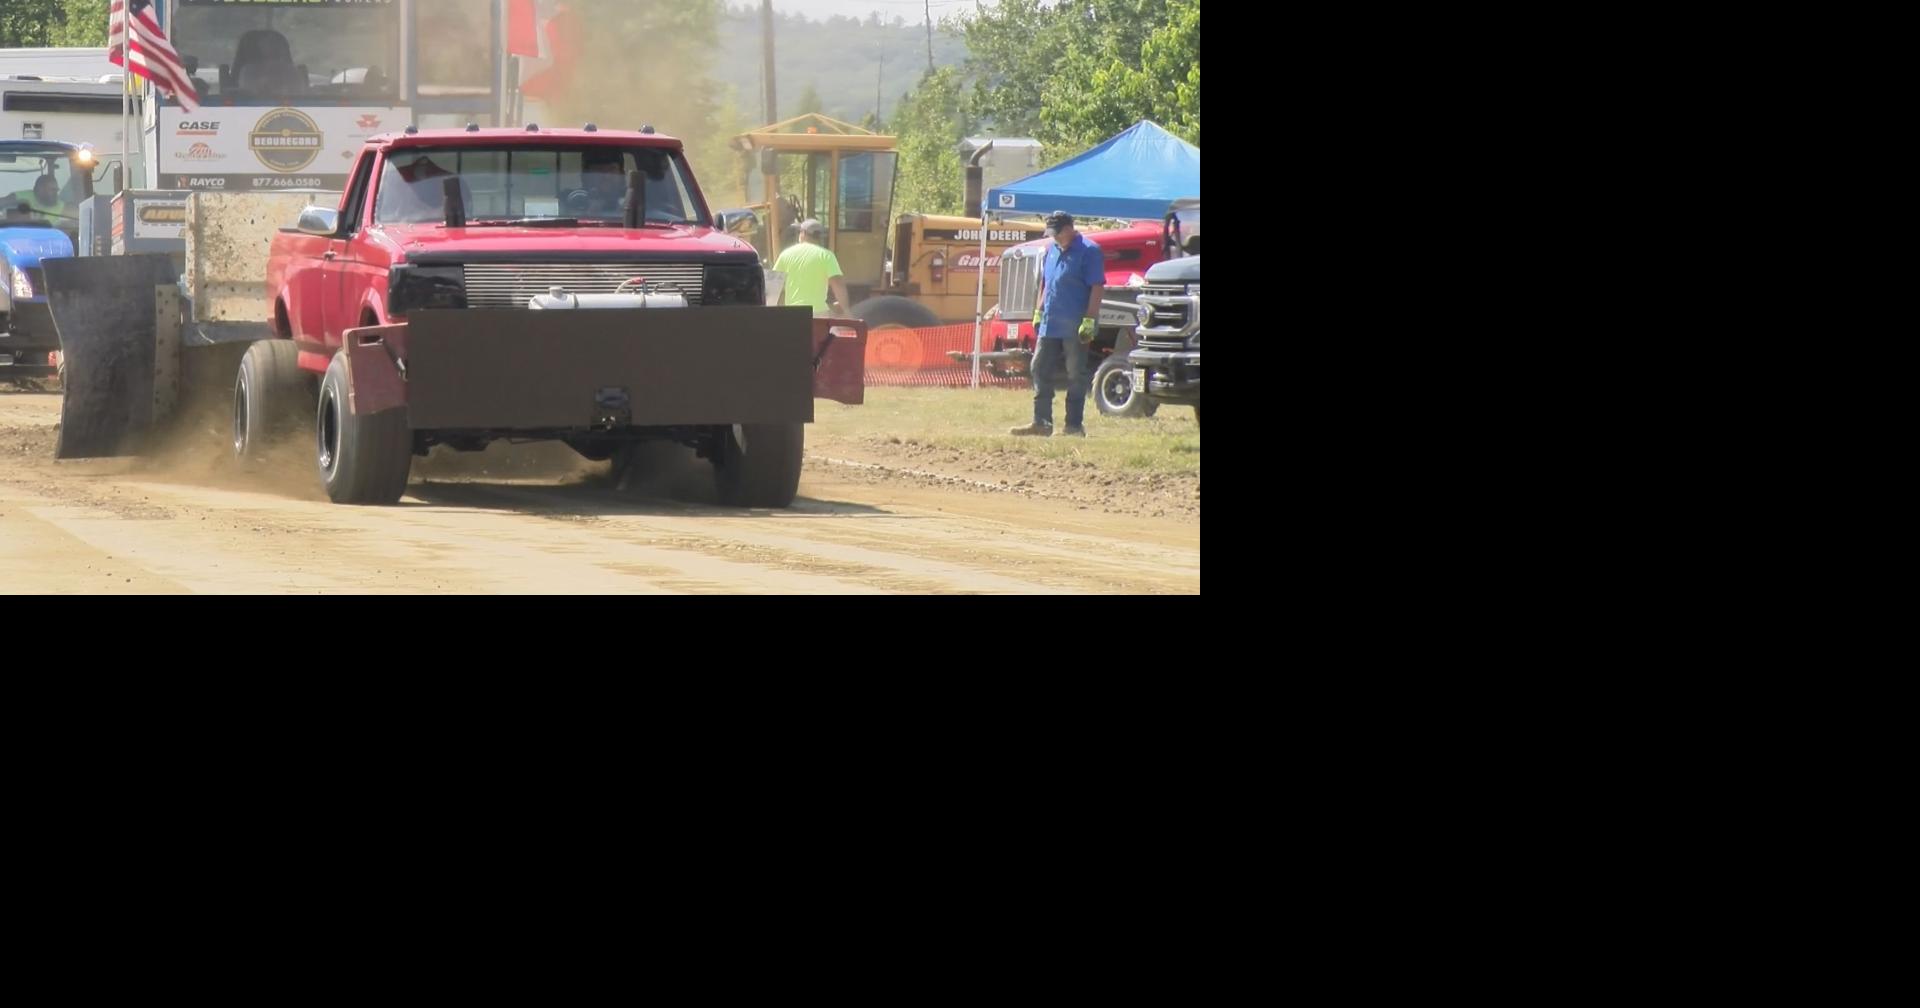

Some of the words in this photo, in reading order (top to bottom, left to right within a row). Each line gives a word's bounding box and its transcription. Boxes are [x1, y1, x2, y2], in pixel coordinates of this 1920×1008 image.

[179, 121, 221, 130] CASE
[190, 178, 225, 186] RAYCO
[252, 178, 321, 187] 877.666.0580
[990, 230, 1027, 241] DEERE
